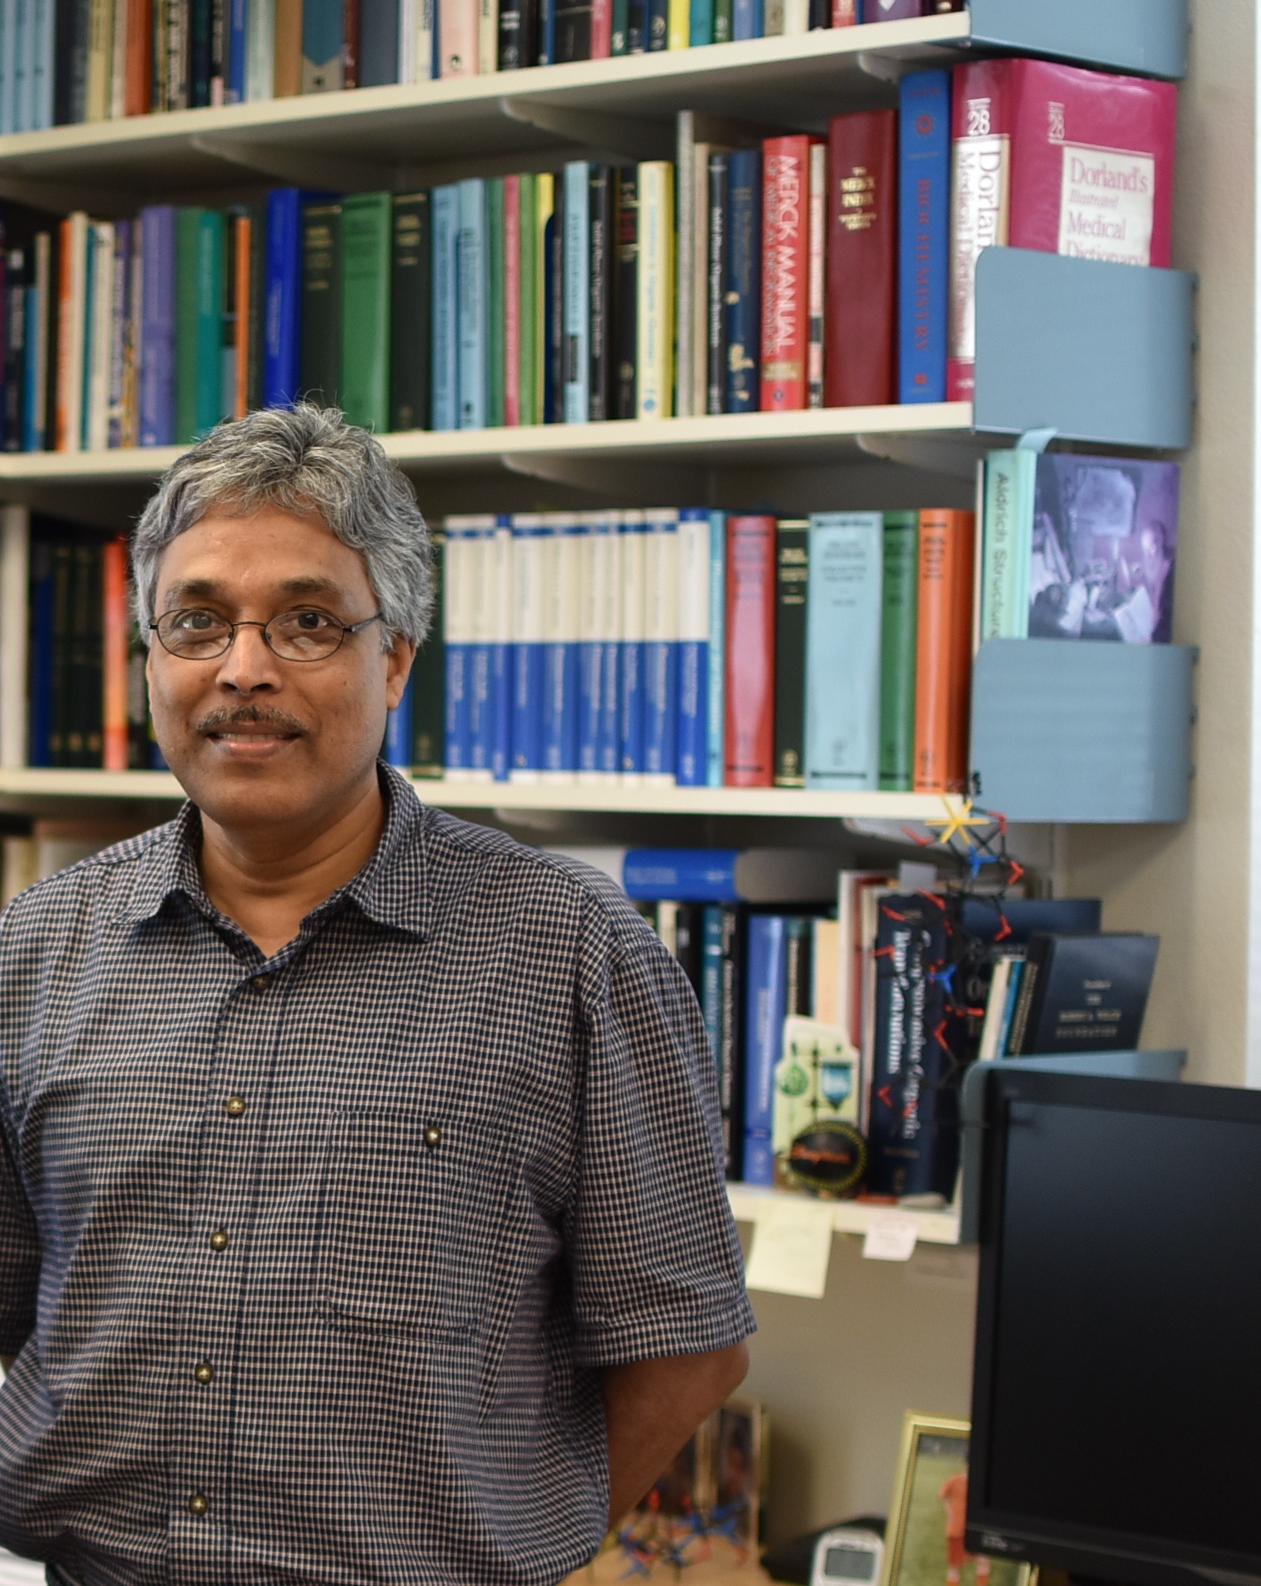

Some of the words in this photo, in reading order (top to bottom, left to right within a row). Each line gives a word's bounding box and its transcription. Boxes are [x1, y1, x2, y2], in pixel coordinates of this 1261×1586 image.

[968, 108, 992, 136] 28
[1049, 114, 1065, 141] 28
[777, 156, 800, 242] MERCK
[956, 151, 976, 228] Medical
[1069, 157, 1149, 193] Dorland's
[1066, 210, 1127, 241] Medical
[775, 246, 798, 356] MANUAL
[914, 178, 933, 353] BIOCHEMISTRY
[993, 473, 1010, 544] Aldrich
